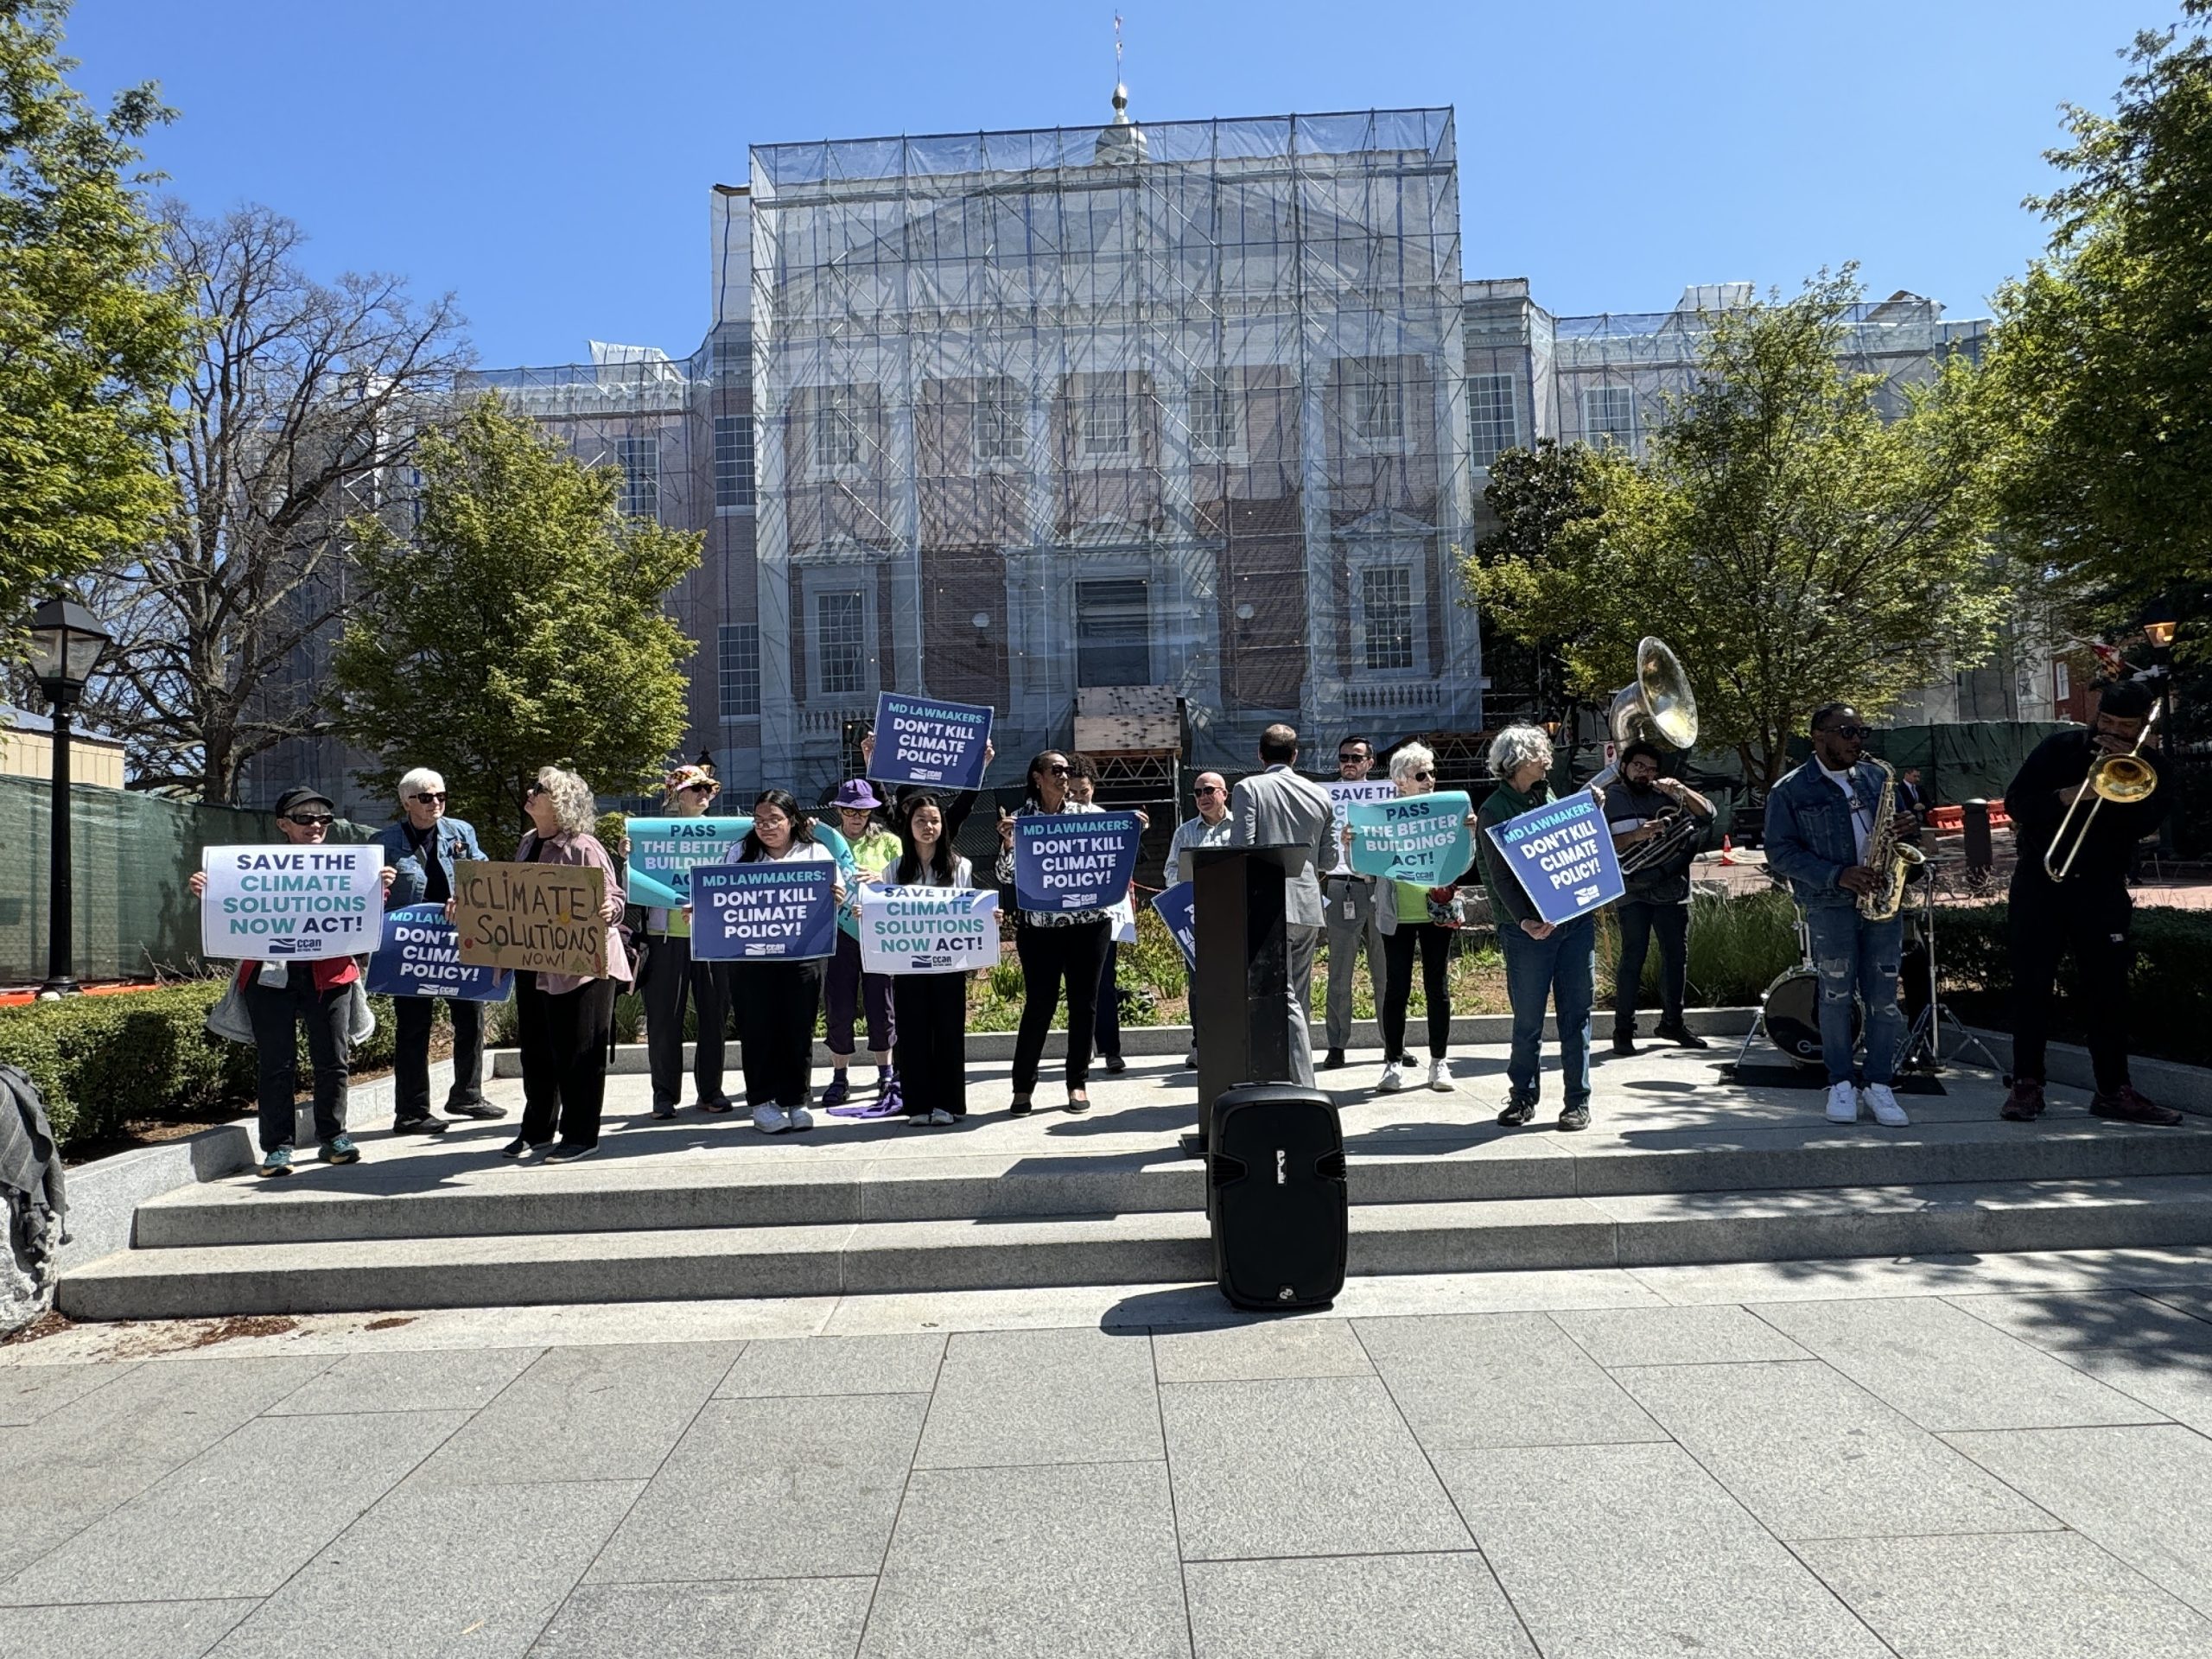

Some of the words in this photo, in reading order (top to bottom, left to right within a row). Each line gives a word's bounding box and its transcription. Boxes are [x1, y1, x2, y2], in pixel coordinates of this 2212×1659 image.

[888, 702, 907, 713] MD
[909, 705, 985, 724] LAWMAKERS:
[893, 718, 944, 735] DON'T
[945, 725, 975, 740] KILL
[899, 734, 965, 753] CLIMATE
[897, 748, 958, 766] POLICY!
[1331, 787, 1372, 801] SAVE
[1376, 786, 1396, 799] TH
[1386, 803, 1430, 821] PASS
[671, 824, 716, 837] PASS
[1023, 825, 1044, 836] MD
[1046, 820, 1133, 835] LAWMAKERS:
[1361, 825, 1394, 837] THE
[1396, 814, 1458, 836] BETTER
[1503, 829, 1525, 844] MD
[1524, 802, 1595, 835] LAWMAKERS:
[641, 841, 676, 854] THE
[680, 841, 734, 854] BETTE
[1033, 838, 1088, 855] DON'T
[1091, 836, 1125, 851] KILL
[1365, 831, 1457, 852] BUILDINGS
[1520, 829, 1570, 860] DON'T
[1570, 820, 1597, 841] KILL
[237, 855, 304, 870] SAVE
[310, 855, 356, 870] THE
[645, 856, 724, 870] BUILDIN
[1042, 854, 1116, 872] CLIMATE
[1392, 851, 1434, 866] ACT!
[1540, 839, 1598, 872] CLIMATE
[702, 875, 728, 887] MD
[729, 870, 826, 886] LAWMAKERS:
[1043, 870, 1111, 889] POLICY!
[1549, 857, 1601, 890] POLICY!
[240, 875, 351, 892] CLIMATE
[713, 889, 776, 907] DON'T
[779, 887, 817, 903] KILL
[884, 887, 935, 898] SAVE
[223, 896, 366, 913] SOLUTIONS
[887, 900, 971, 916] CLIMATE
[389, 912, 413, 922] MD
[723, 906, 807, 923] CLIMATE
[230, 918, 296, 934] NOW
[302, 917, 363, 933] ACT!
[724, 921, 802, 938] POLICY!
[874, 918, 984, 935] SOLUTIONS
[395, 926, 459, 945] DON'T
[880, 938, 930, 952] NOW
[935, 937, 983, 950] ACT!
[403, 945, 460, 963] CLIMA
[400, 963, 480, 982] POLICY!
